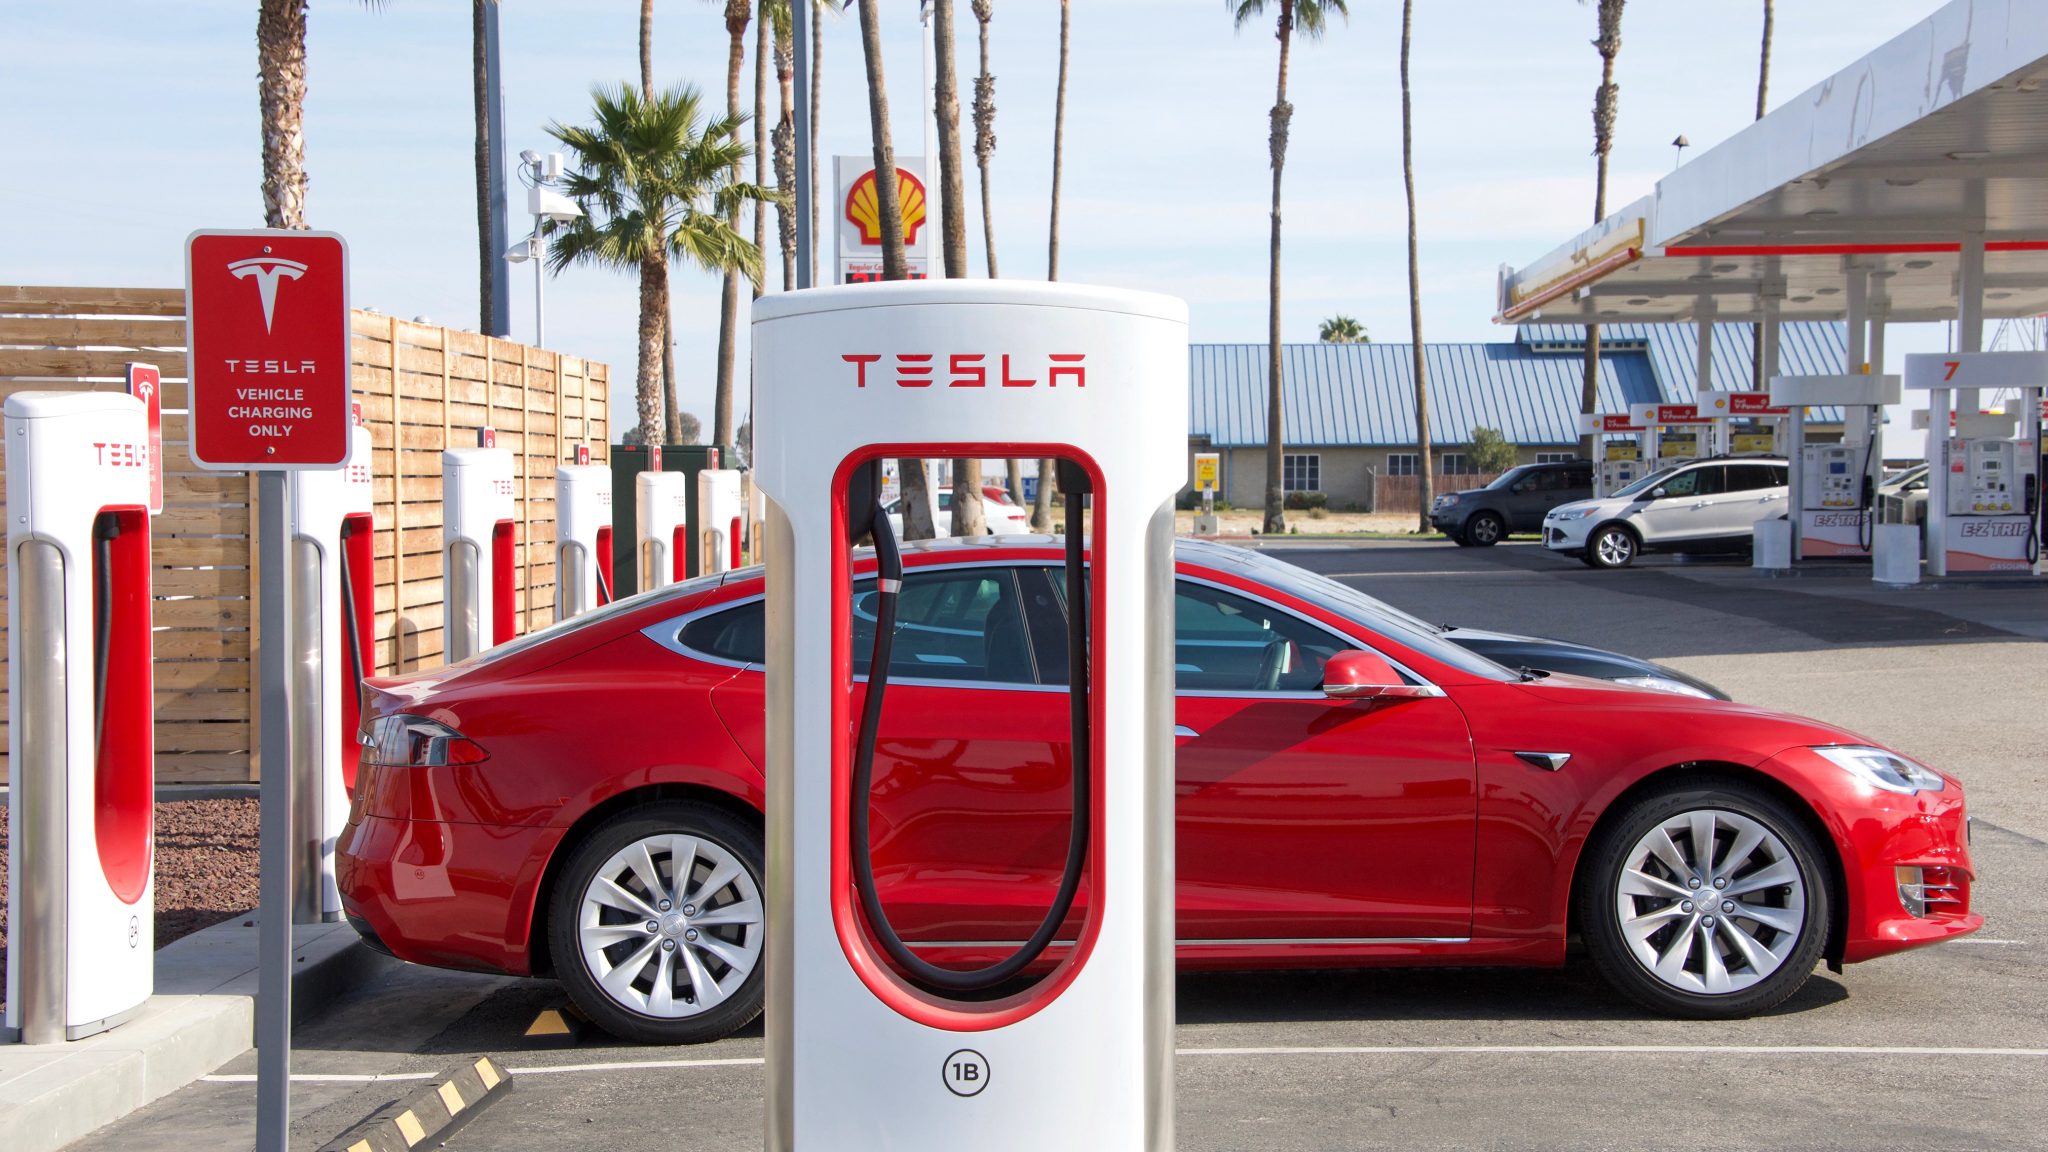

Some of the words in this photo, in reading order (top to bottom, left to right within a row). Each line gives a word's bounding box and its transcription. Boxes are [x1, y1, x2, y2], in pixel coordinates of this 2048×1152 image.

[224, 359, 316, 374] TESLA
[841, 353, 1086, 388] TESLA
[1943, 361, 1961, 382] 7
[236, 388, 304, 401] VEHICLE
[228, 406, 313, 419] CHARGING
[249, 424, 294, 437] ONLY
[1991, 522, 2031, 538] TRIP
[952, 1062, 980, 1081] 1B
